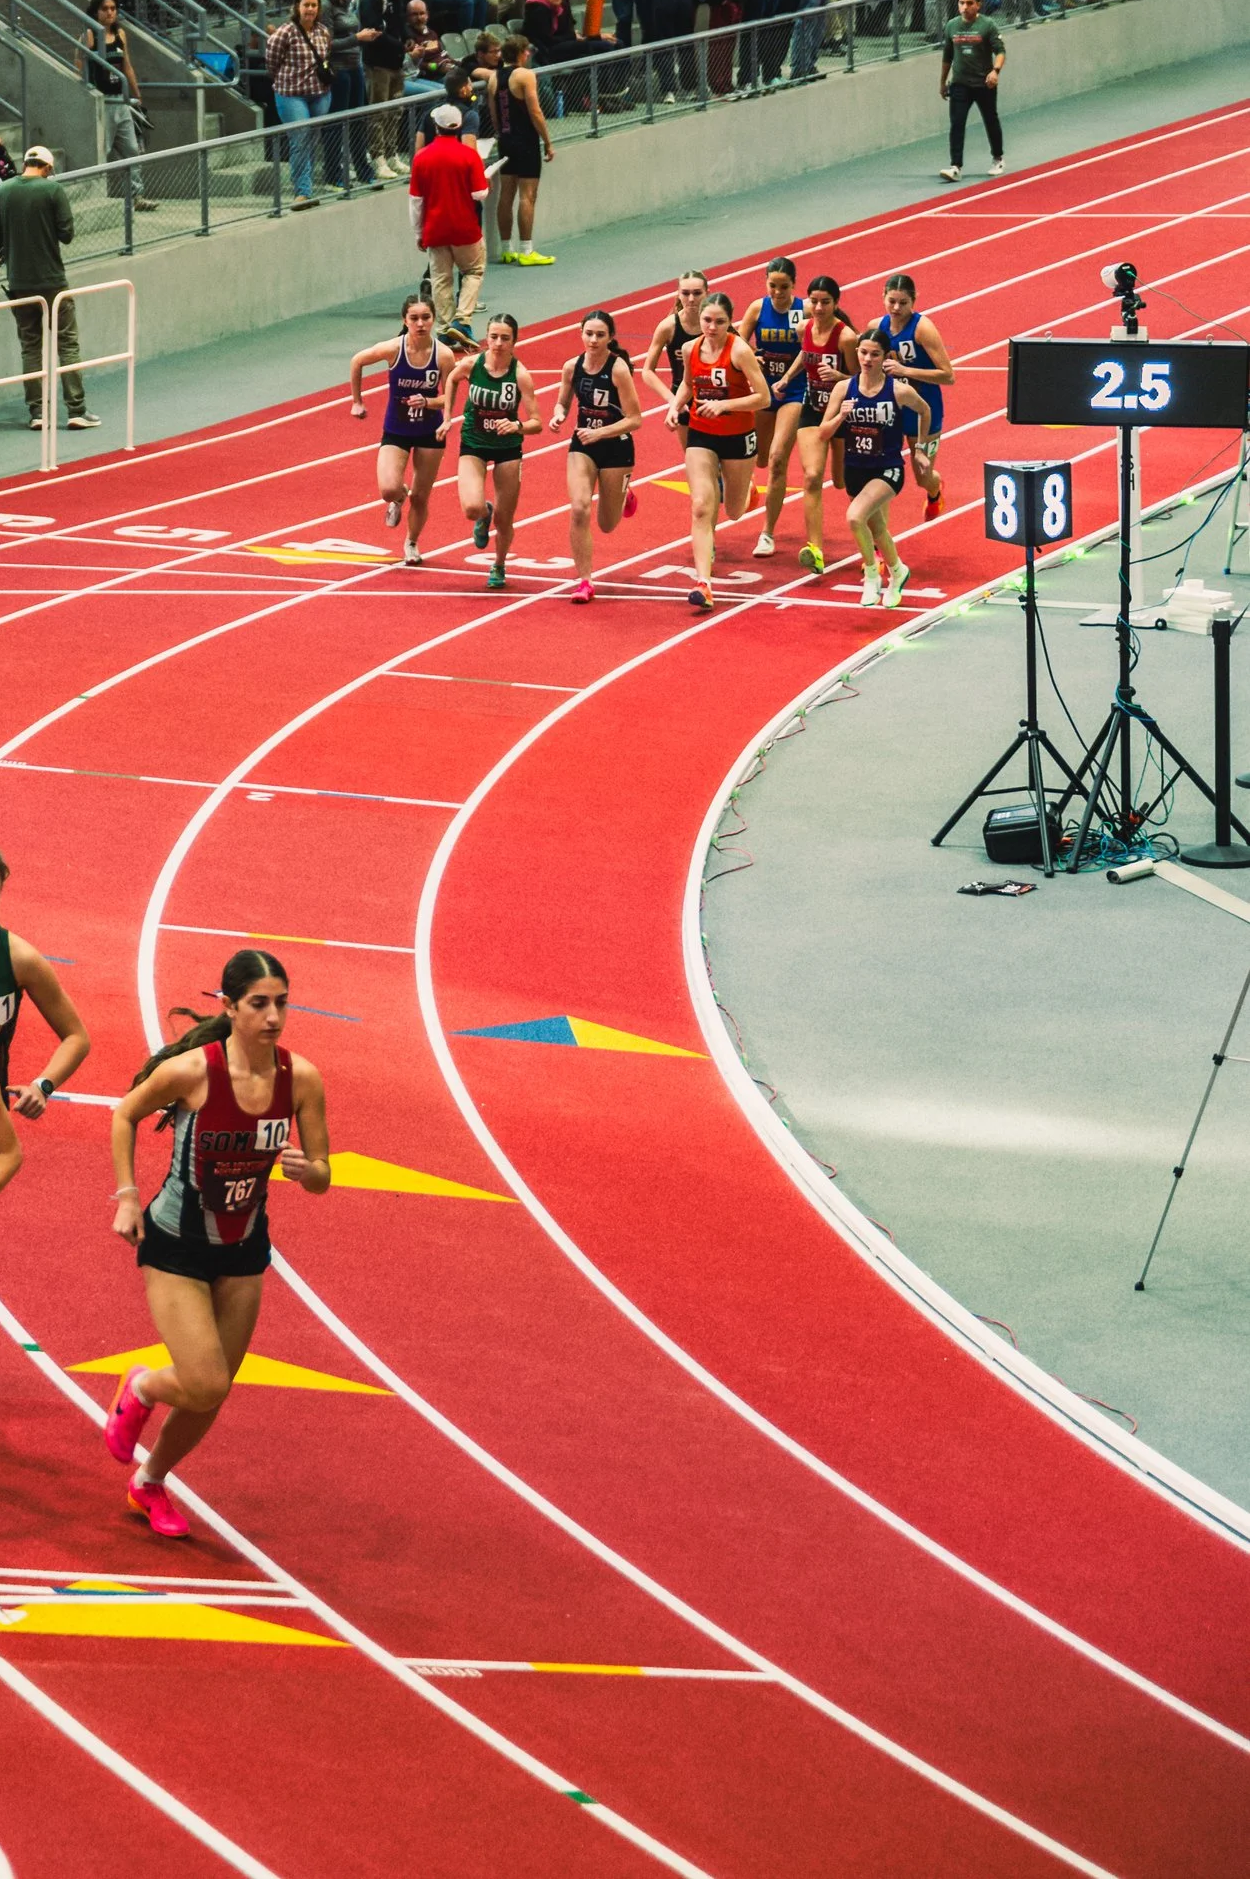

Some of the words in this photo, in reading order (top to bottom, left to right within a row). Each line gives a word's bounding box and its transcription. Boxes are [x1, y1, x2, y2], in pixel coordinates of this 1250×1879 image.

[792, 312, 799, 324] 4
[902, 342, 913, 359] 2
[769, 362, 785, 373] 519
[429, 371, 437, 387] 9
[714, 370, 723, 387] 5
[1091, 361, 1171, 411] 2.5
[505, 384, 514, 401] 8
[597, 391, 605, 406] 7
[817, 390, 831, 403] 76
[882, 403, 889, 421] 1
[748, 434, 756, 452] 5
[855, 436, 873, 450] 243
[993, 474, 1018, 539] 8
[1043, 473, 1066, 538] 8
[264, 1121, 285, 1149] 10
[224, 1177, 257, 1204] 767
